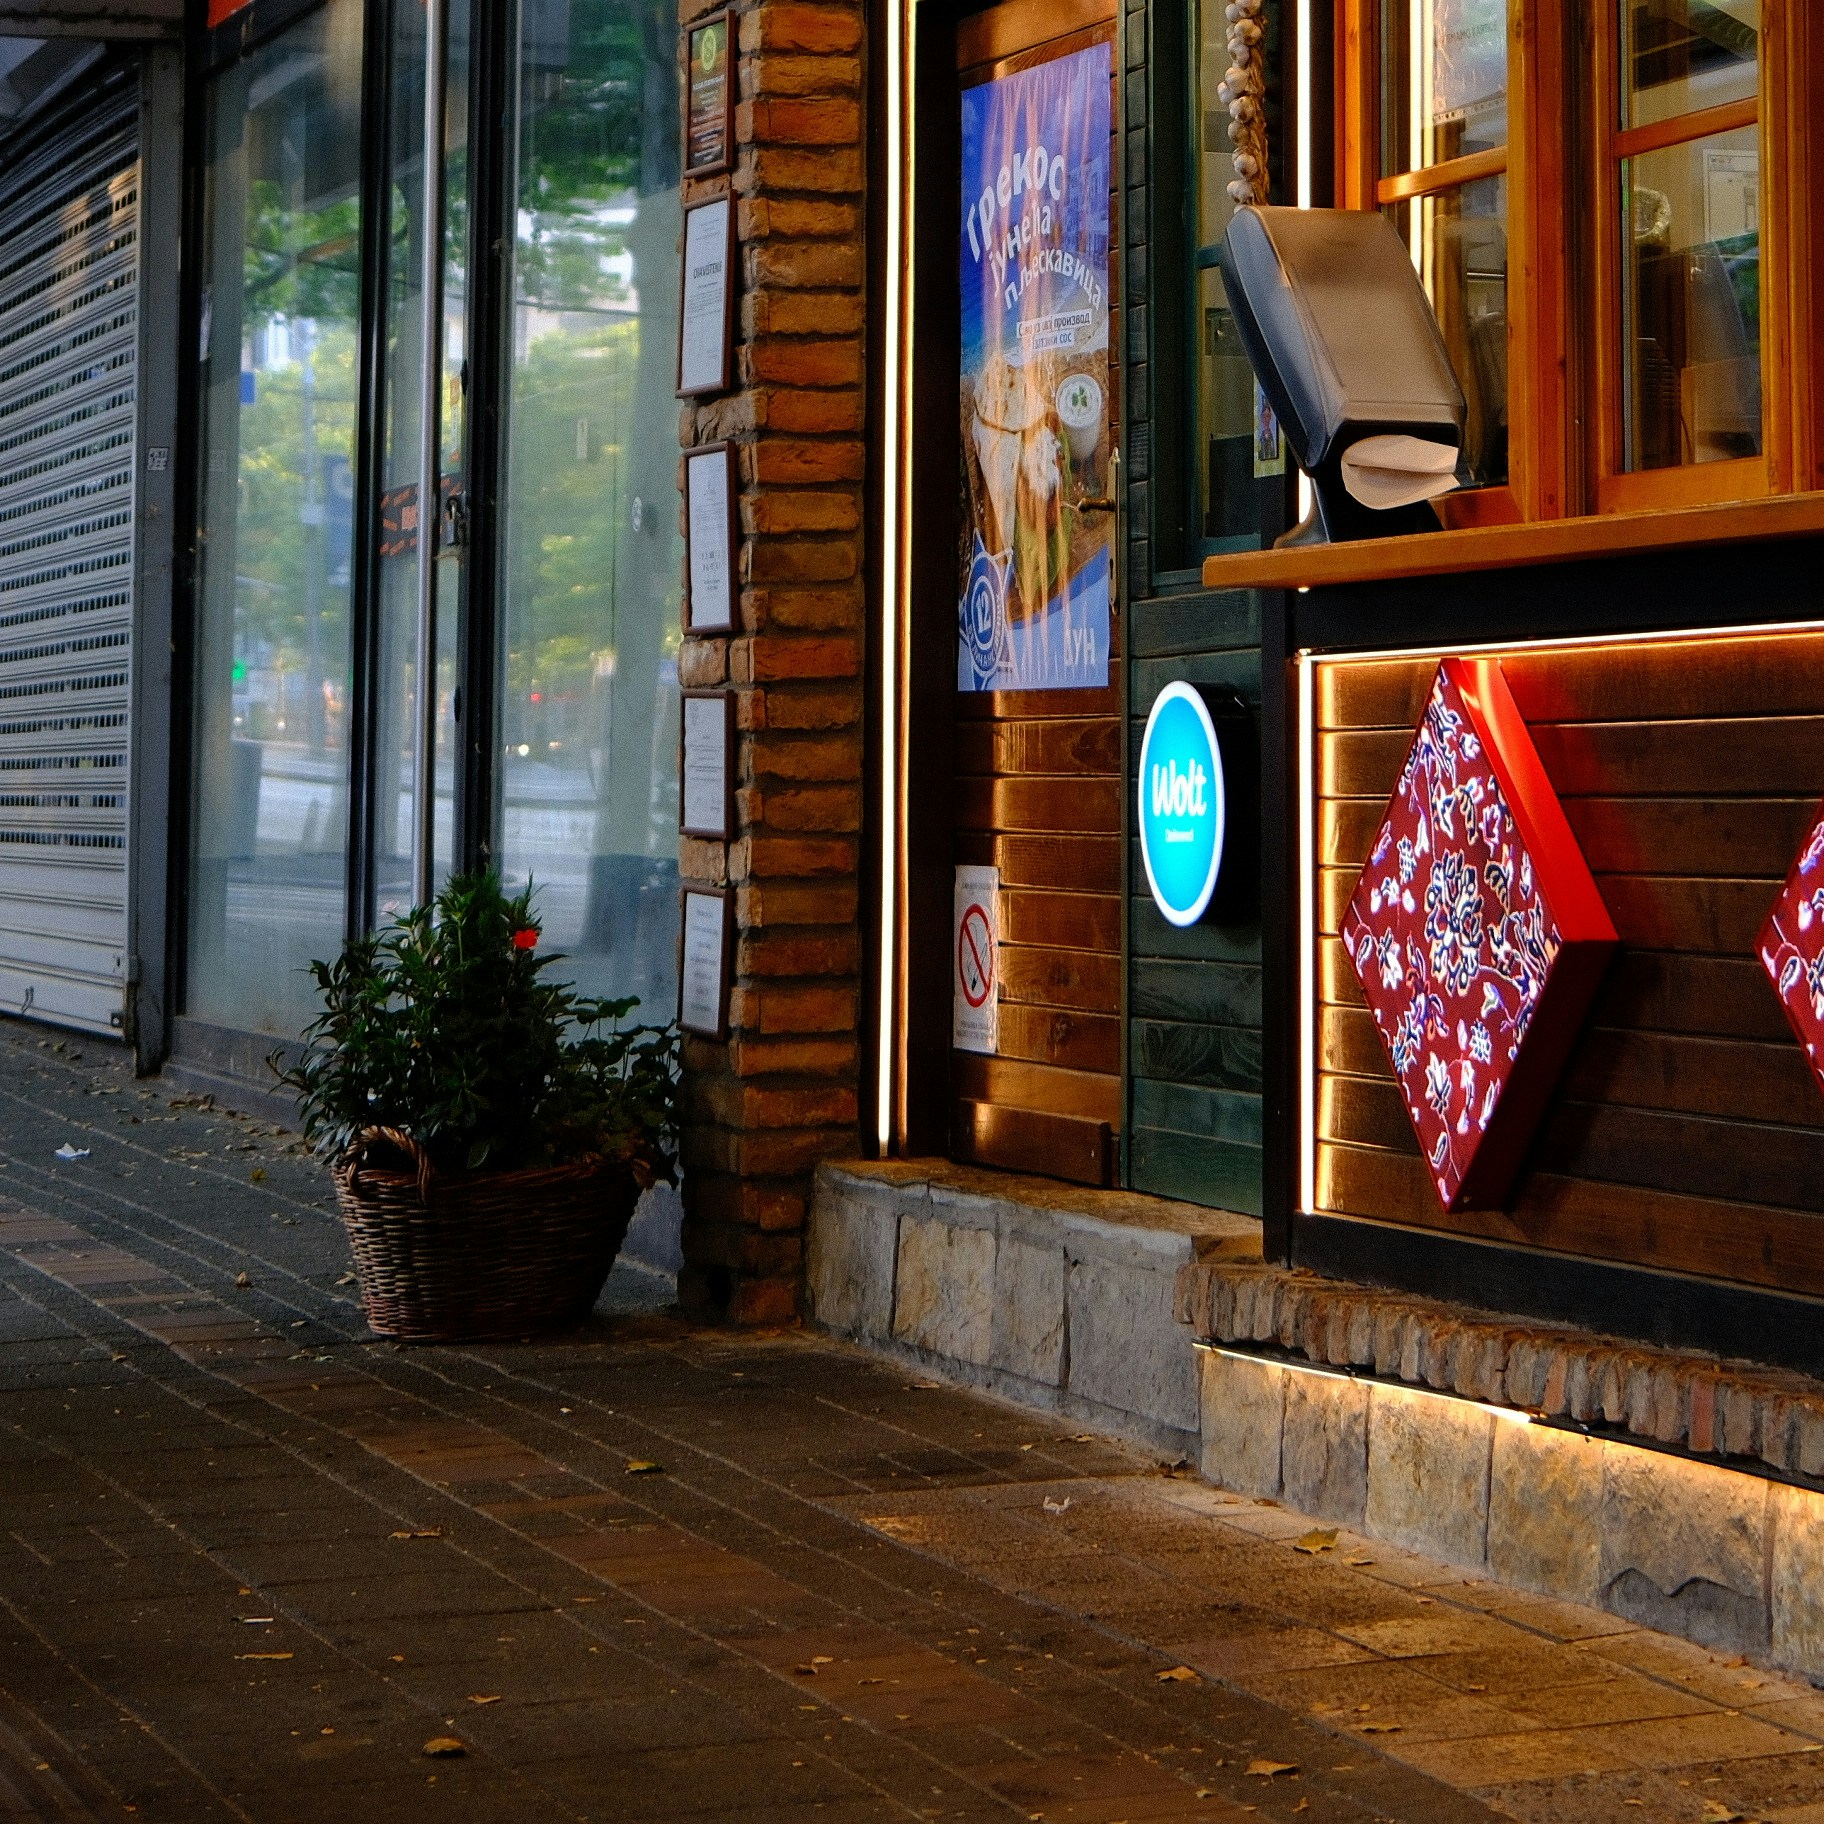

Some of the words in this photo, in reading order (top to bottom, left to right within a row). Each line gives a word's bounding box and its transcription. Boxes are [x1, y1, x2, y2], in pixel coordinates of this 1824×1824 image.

[989, 200, 1051, 298] јунећа
[1004, 247, 1102, 310] пљескавица
[1054, 313, 1089, 328] производ
[1060, 333, 1072, 343] сос
[976, 591, 992, 634] 12
[1152, 759, 1207, 817] Wolt
